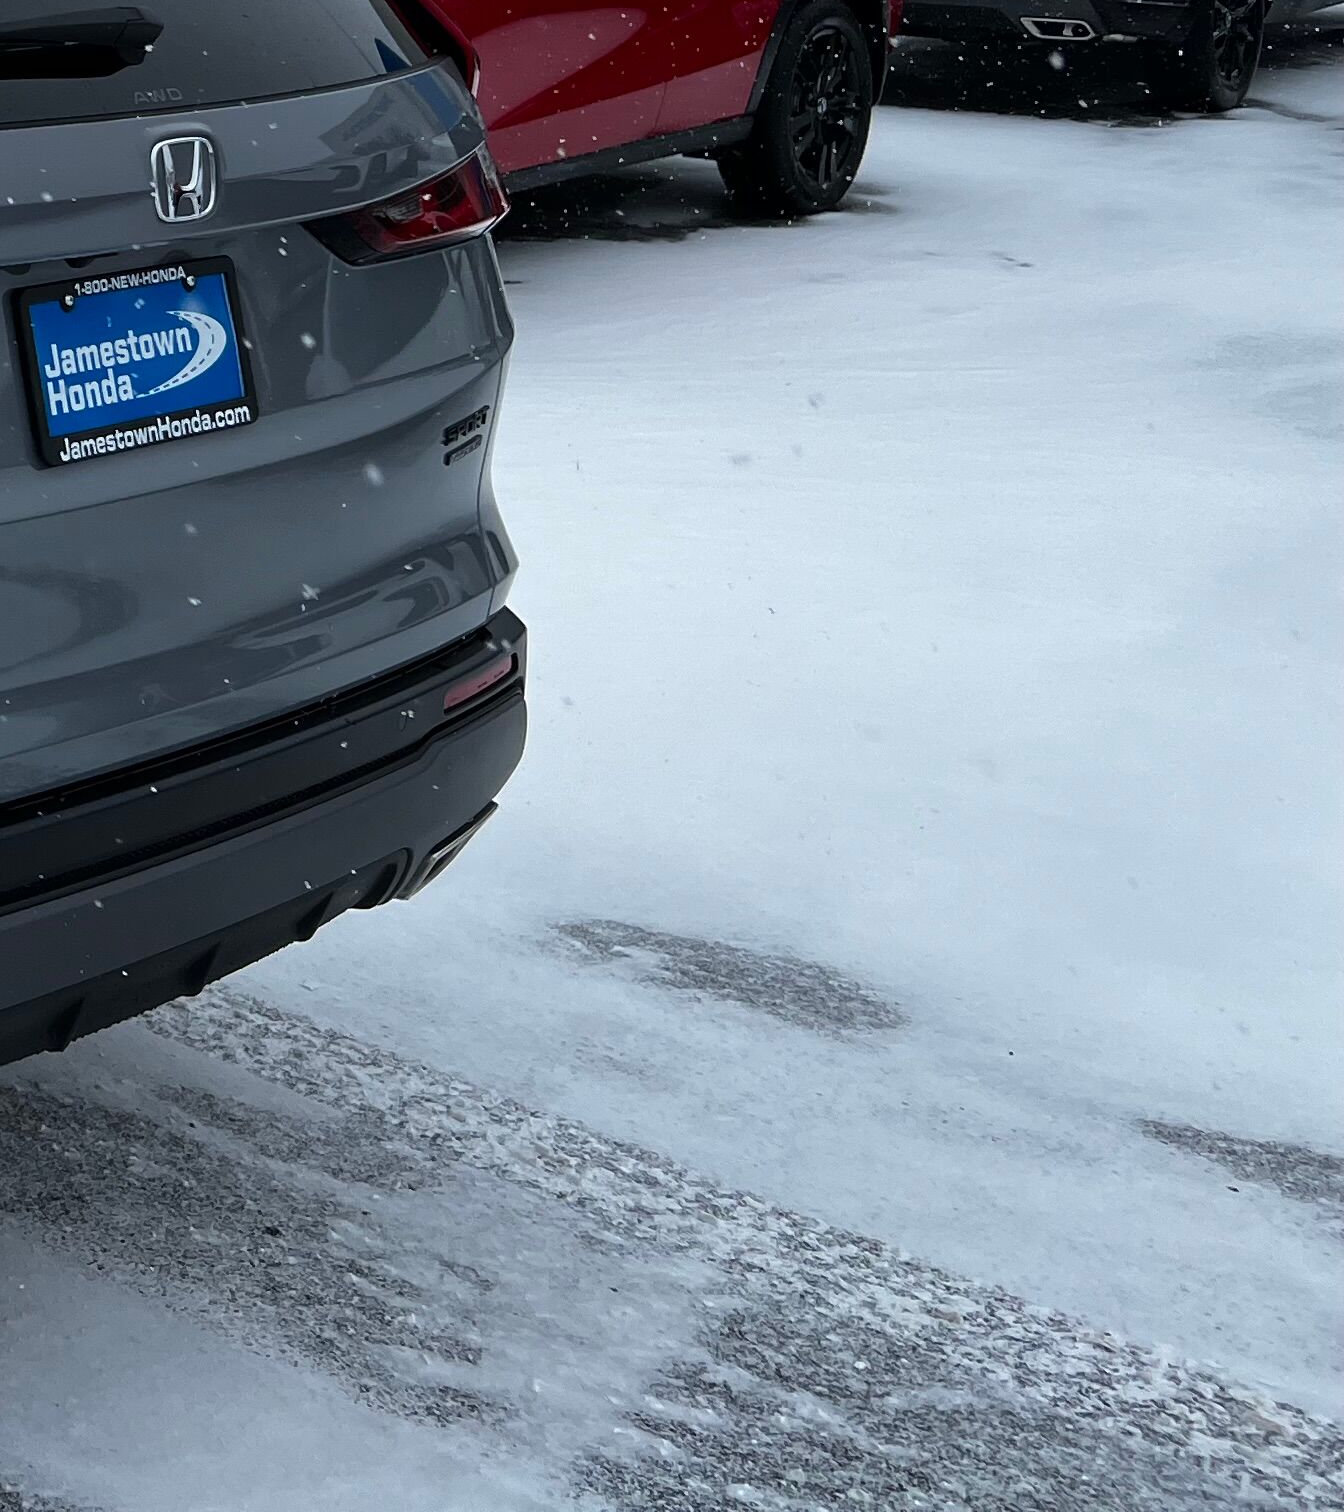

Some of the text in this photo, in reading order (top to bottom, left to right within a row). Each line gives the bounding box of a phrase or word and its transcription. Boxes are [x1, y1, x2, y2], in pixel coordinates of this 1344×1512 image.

[134, 87, 183, 105] AWD
[73, 265, 187, 297] 1-800-NEW-HONDA
[44, 325, 193, 379] Jamestown
[45, 366, 137, 417] Honda
[59, 404, 252, 463] JamestownHonda.com
